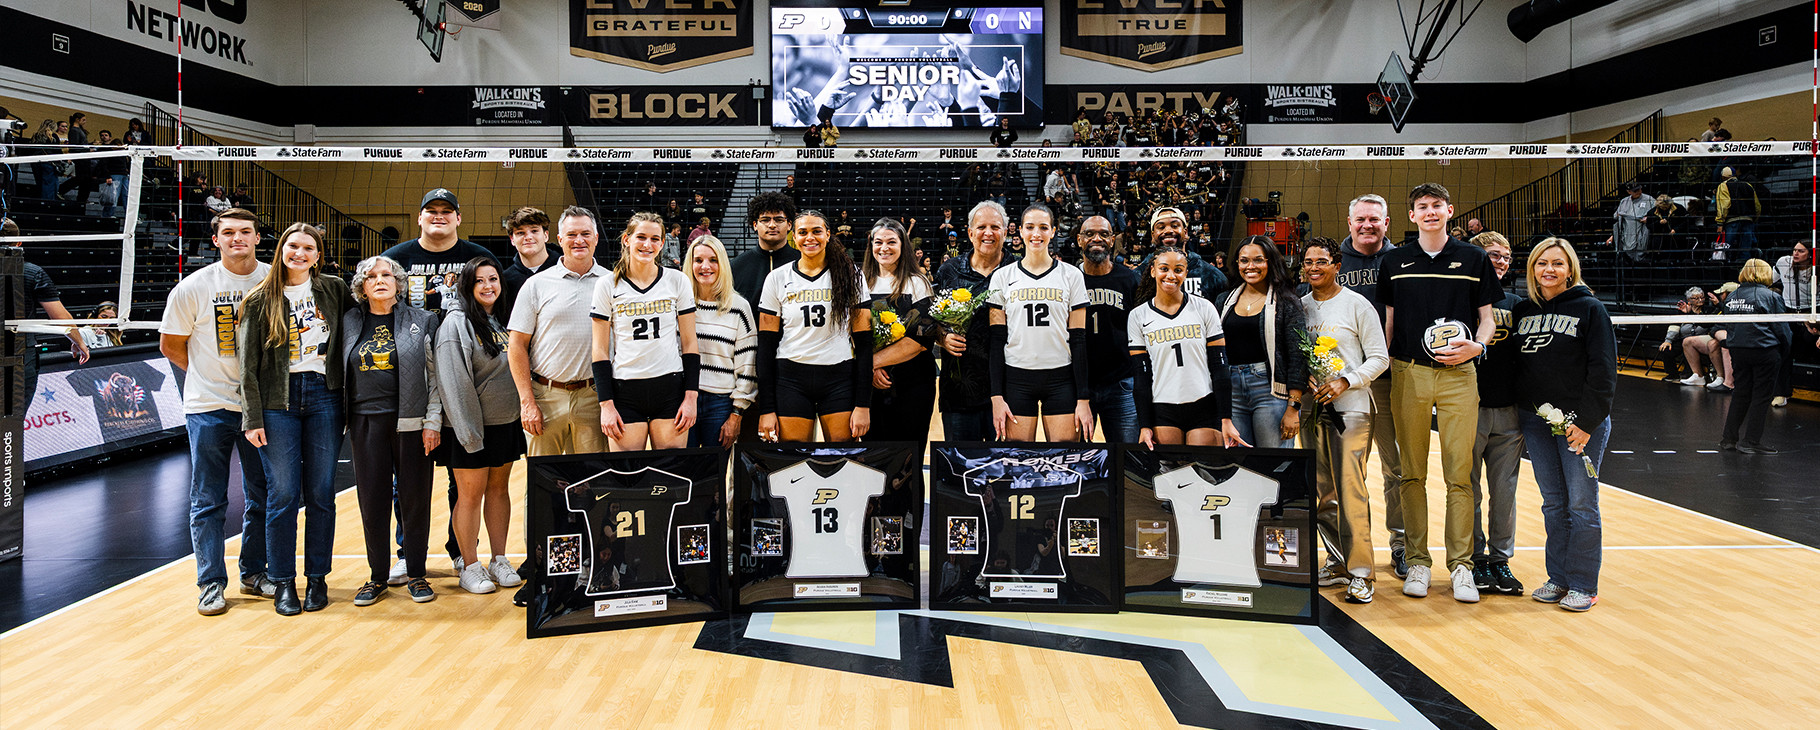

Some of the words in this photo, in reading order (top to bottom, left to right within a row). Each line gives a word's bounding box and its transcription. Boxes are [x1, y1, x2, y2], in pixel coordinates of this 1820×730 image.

[463, 2, 483, 12] 2020
[593, 20, 732, 31] GRATEFUL
[888, 14, 928, 25] 90:00
[986, 14, 999, 29] 0
[1019, 12, 1031, 30] N
[1118, 20, 1187, 30] TRUE
[127, 0, 247, 65] NETWORK
[647, 43, 677, 60] Purdue
[1137, 41, 1167, 60] Purdue
[849, 65, 960, 85] SENIOR
[881, 86, 931, 102] DAY
[589, 93, 738, 119] BLOCK
[1077, 92, 1221, 117] PARTY
[1286, 108, 1308, 116] LOCATED
[1309, 108, 1315, 116] IN
[217, 147, 257, 158] PURDUE
[363, 148, 402, 158] PURDUE
[508, 149, 548, 159] PURDUE
[653, 149, 692, 159] PURDUE
[797, 149, 835, 159] PURDUE
[939, 149, 978, 159] PURDUE
[1082, 148, 1120, 158] PURDUE
[1224, 148, 1263, 157] PURDUE
[1366, 147, 1405, 156] PURDUE
[1509, 146, 1547, 155] PURDUE
[1651, 144, 1690, 154] PURDUE
[407, 263, 436, 276] JULIA
[212, 290, 243, 304] JULIA
[410, 276, 425, 310] PURD
[786, 288, 833, 304] PURDU
[1010, 287, 1064, 303] PURDUE
[1087, 287, 1125, 311] RDUE
[615, 299, 673, 317] PURDUE
[800, 304, 826, 328] 13
[1023, 303, 1050, 327] 12
[321, 325, 329, 333] 21
[631, 316, 661, 341] 21
[1091, 311, 1099, 334] 1
[216, 305, 236, 358] PURDUE
[1146, 323, 1202, 347] PURDUE
[1430, 325, 1461, 350] P
[1521, 334, 1554, 354] P
[1171, 343, 1184, 368] 1
[4, 431, 13, 468] sports
[3, 469, 13, 508] imports
[812, 488, 839, 505] P
[1008, 494, 1036, 520] 12
[1200, 495, 1231, 511] P
[616, 509, 646, 539] 21
[812, 507, 839, 534] 13
[1210, 514, 1222, 540] 1
